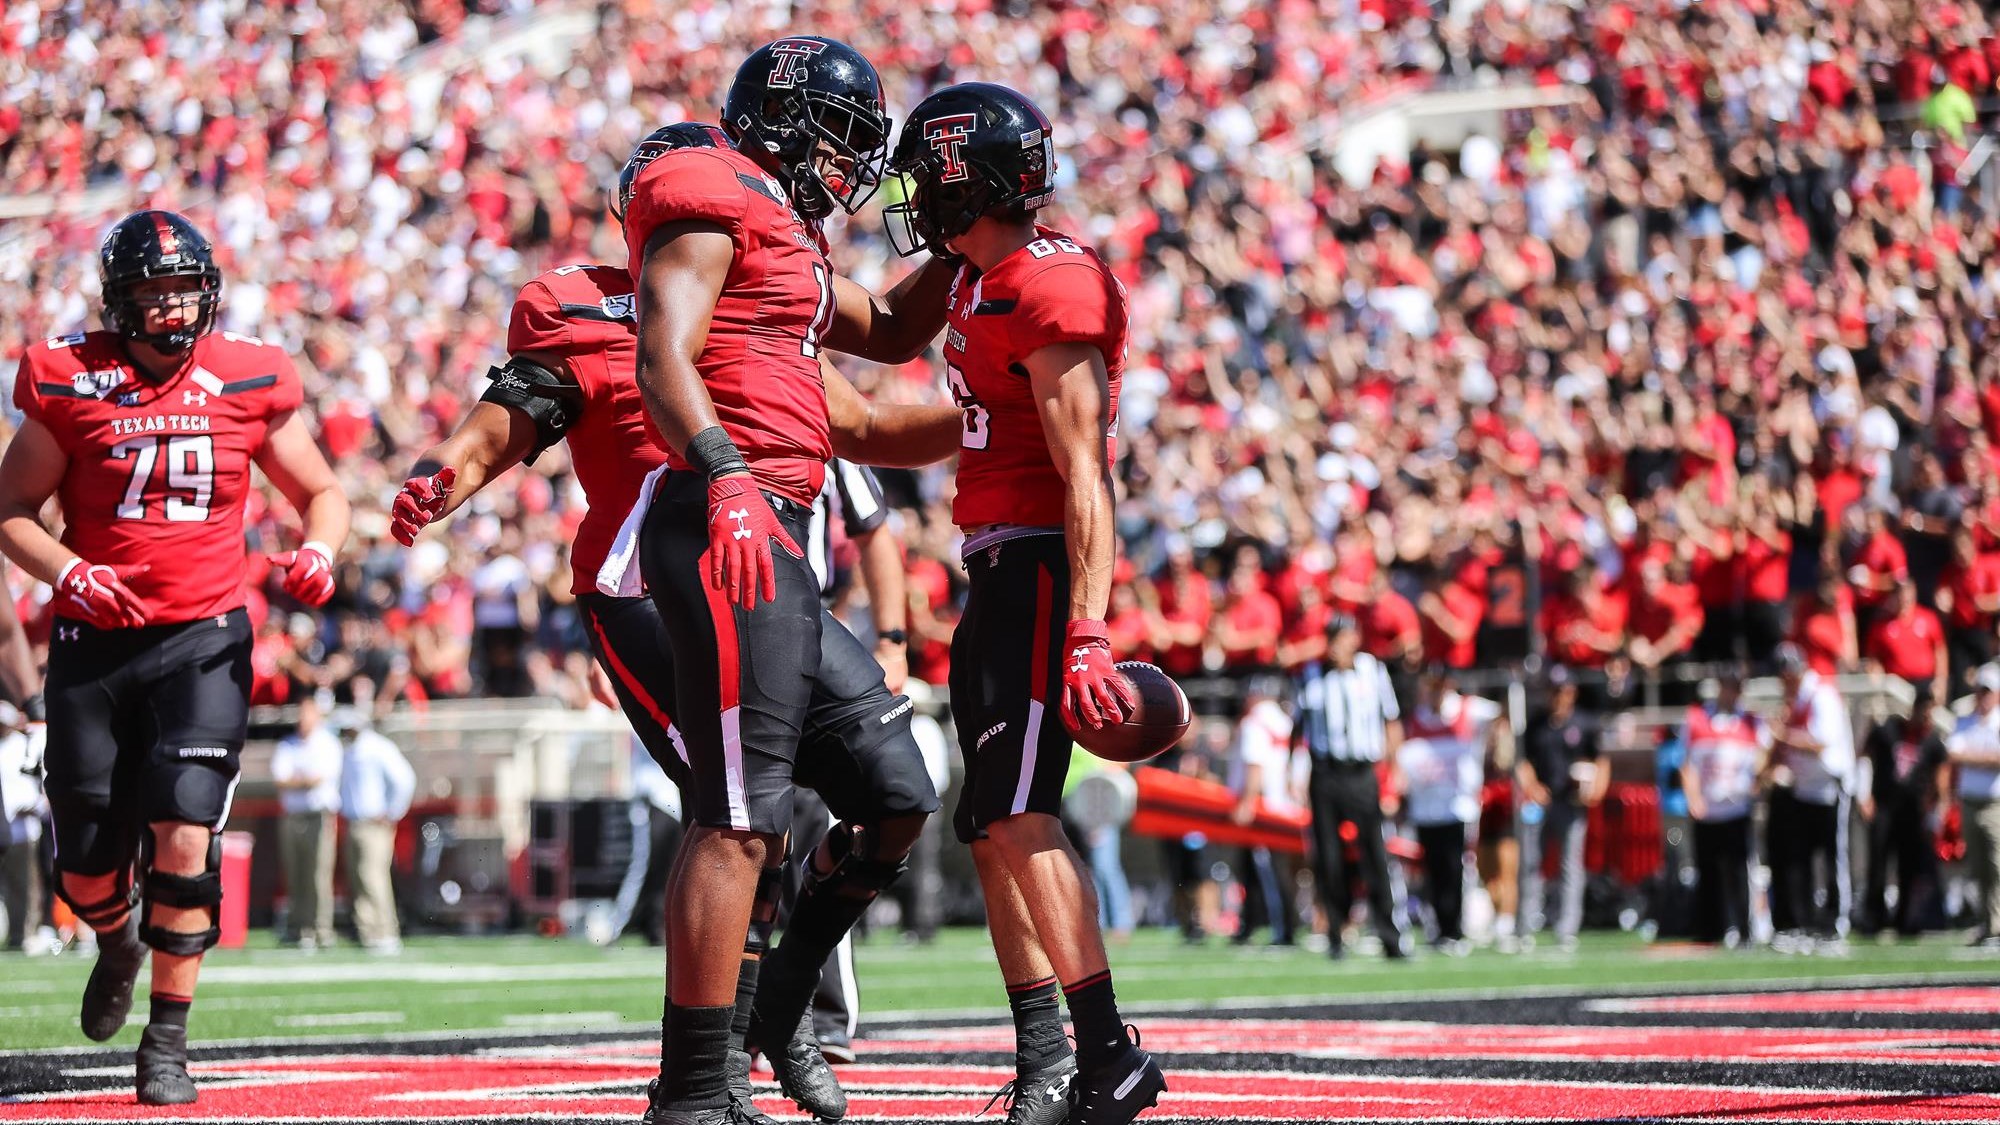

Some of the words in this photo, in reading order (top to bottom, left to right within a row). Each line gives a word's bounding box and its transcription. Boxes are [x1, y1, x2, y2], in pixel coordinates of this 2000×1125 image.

[111, 415, 165, 435] TEXAS
[168, 414, 210, 431] TECH
[110, 434, 215, 523] 79
[988, 721, 1007, 737] UP
